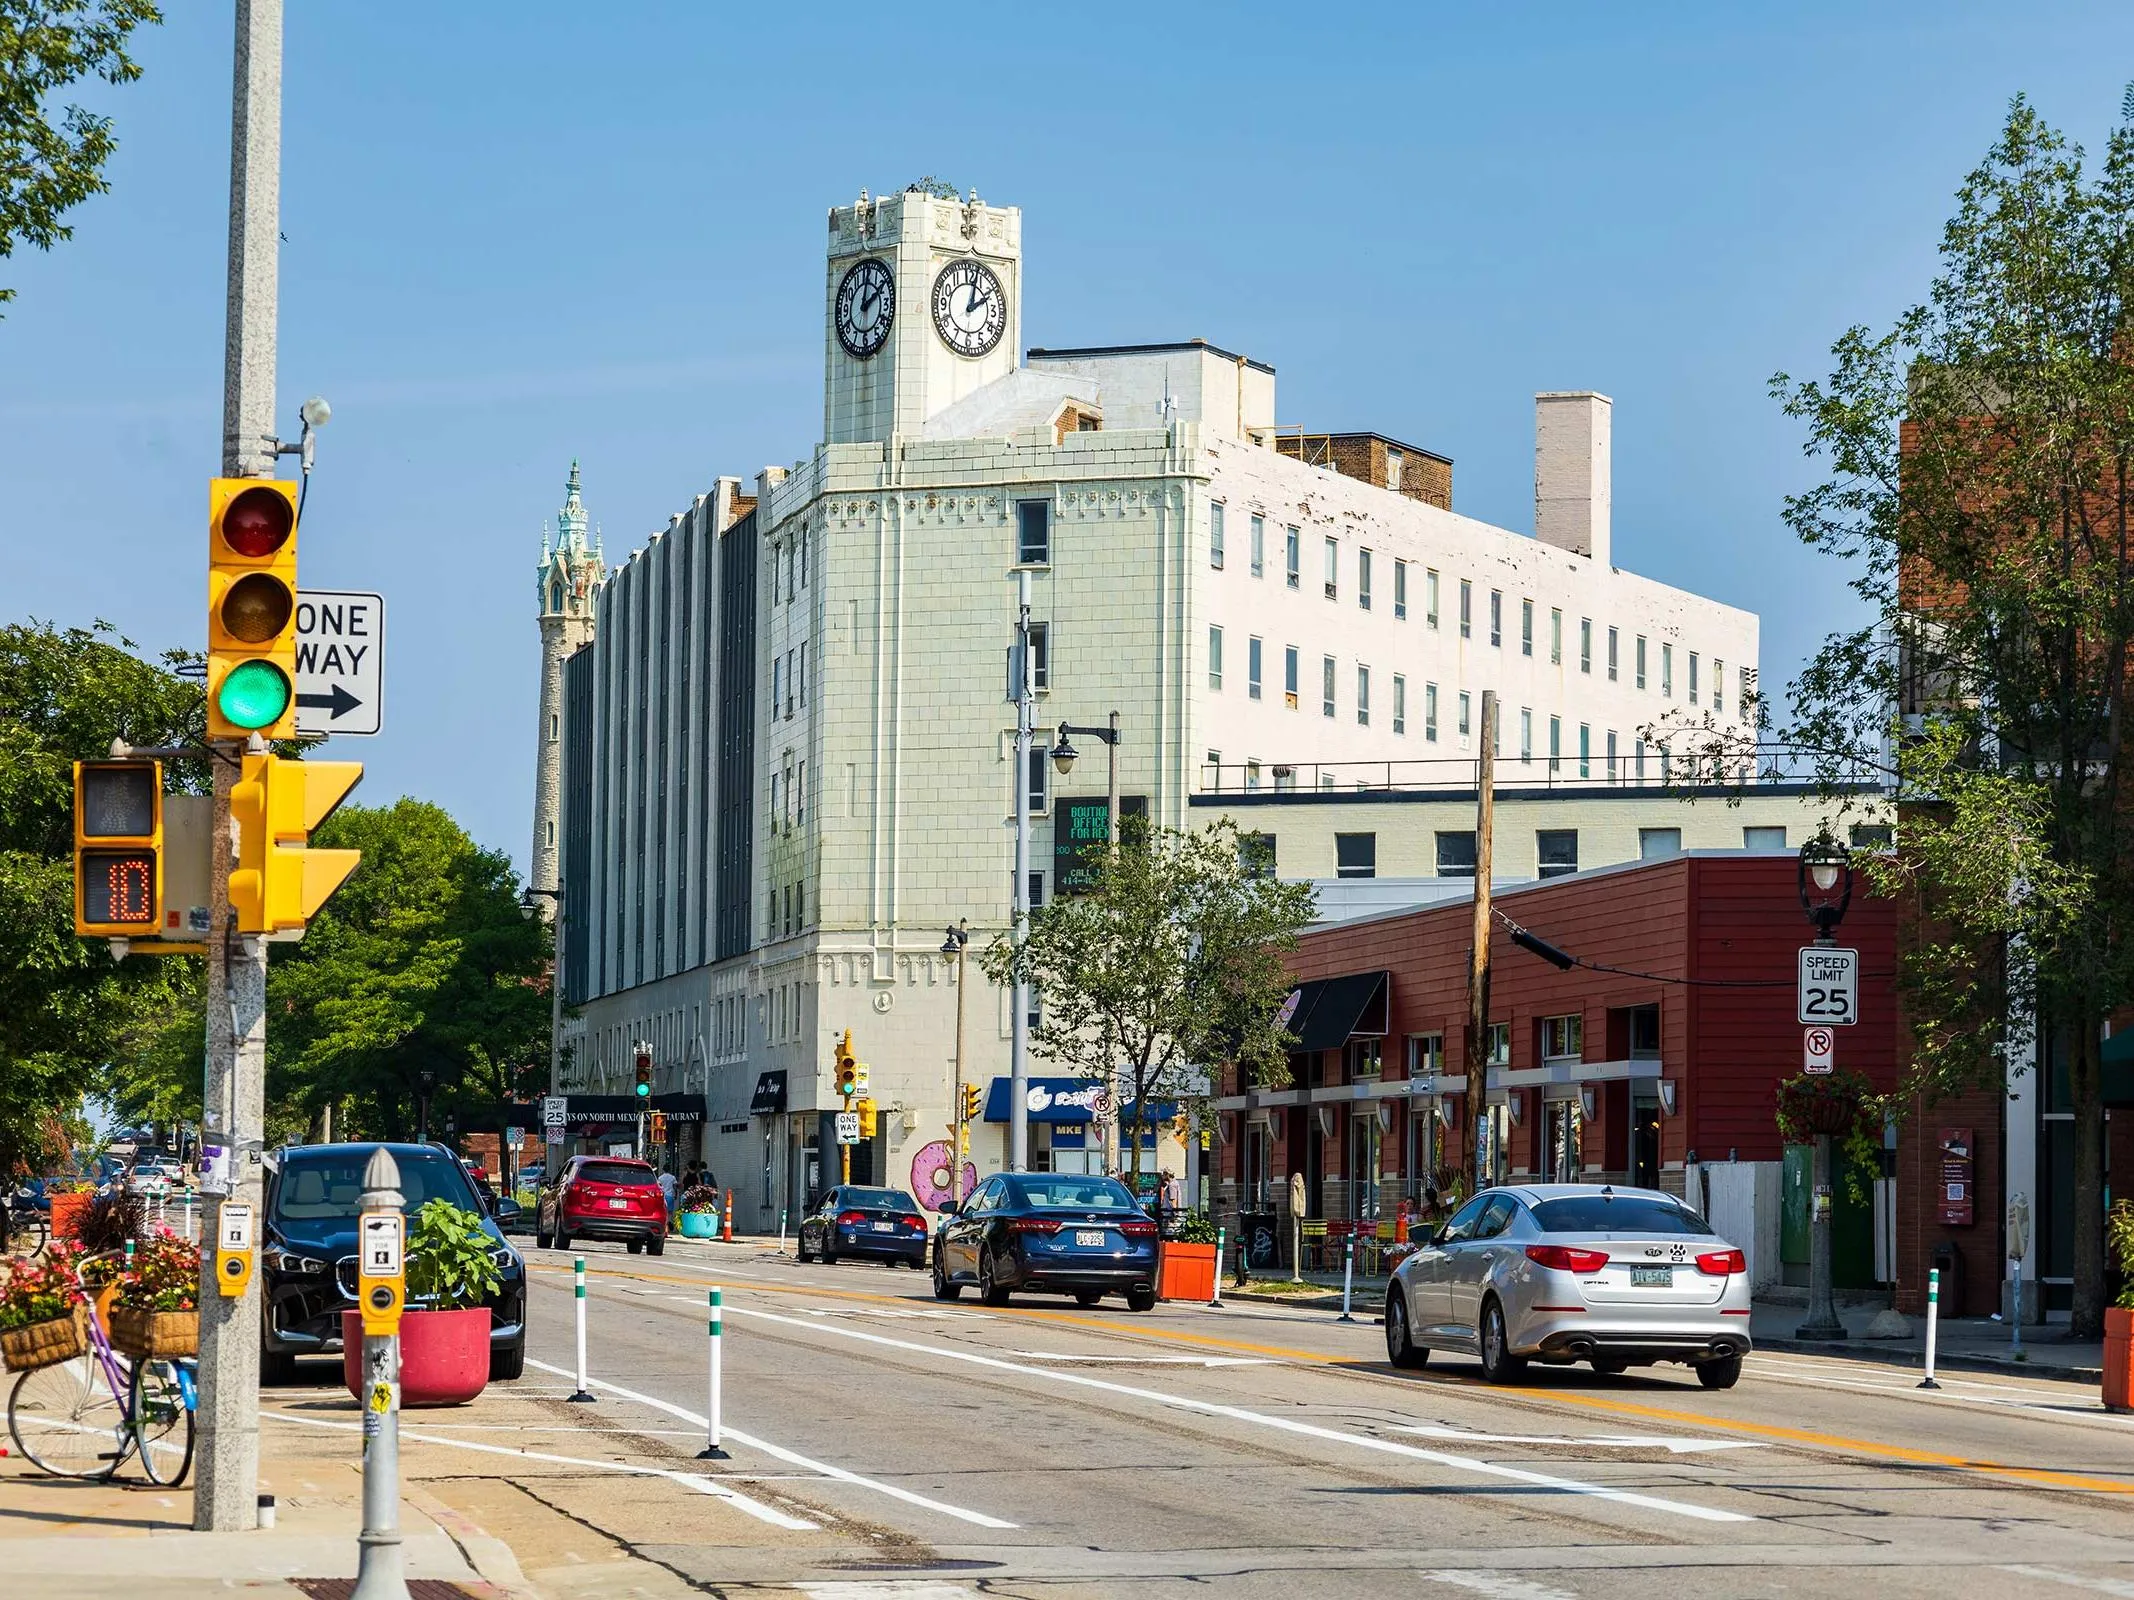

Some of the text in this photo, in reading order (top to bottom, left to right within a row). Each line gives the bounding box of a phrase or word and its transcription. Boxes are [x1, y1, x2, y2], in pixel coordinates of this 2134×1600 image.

[940, 297, 947, 311] 9
[990, 304, 997, 318] 3
[296, 603, 367, 636] ONE
[295, 643, 368, 675] WAY
[1070, 828, 1090, 839] FOR
[1070, 868, 1091, 877] CALL
[109, 860, 149, 920] 10
[1806, 956, 1850, 969] SPEED
[1811, 969, 1845, 982] LIMIT
[1806, 988, 1849, 1015] 25
[546, 1112, 564, 1123] 25
[577, 1112, 588, 1121] ON
[588, 1112, 615, 1122] NORTH
[840, 1115, 857, 1123] ONE
[840, 1123, 857, 1132] WAY
[1056, 1126, 1082, 1135] MKE
[1646, 1248, 1660, 1256] KIA
